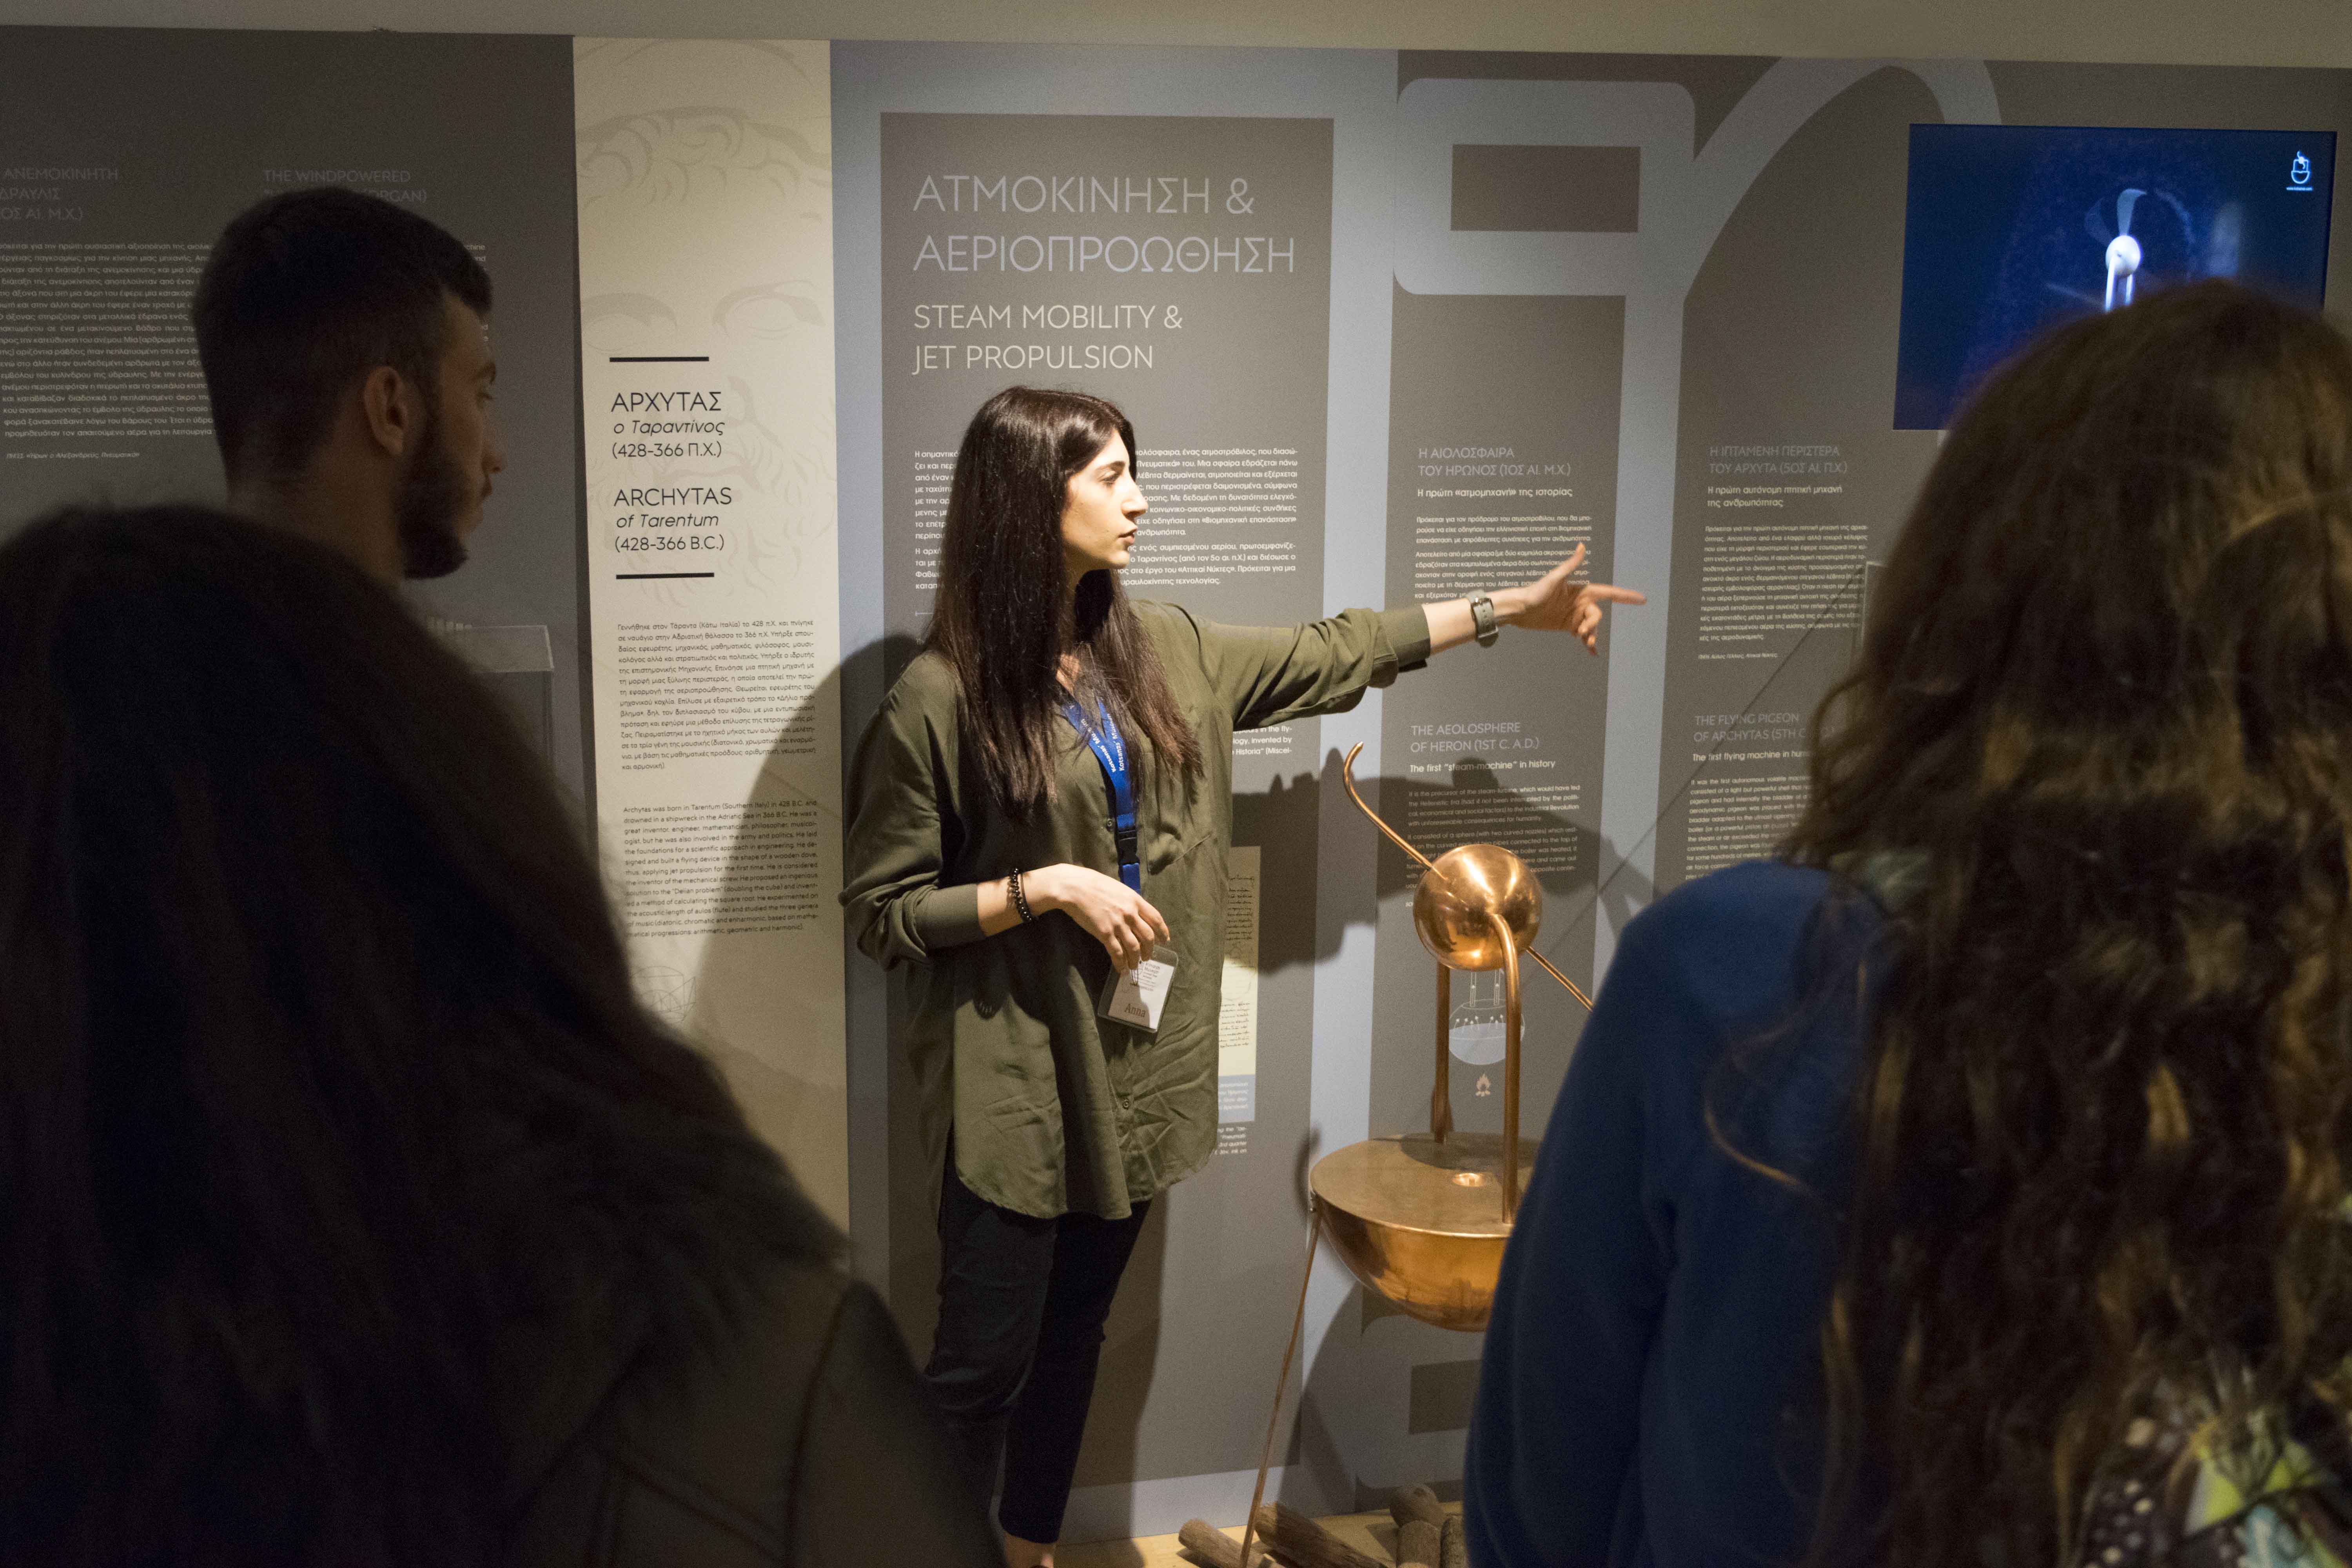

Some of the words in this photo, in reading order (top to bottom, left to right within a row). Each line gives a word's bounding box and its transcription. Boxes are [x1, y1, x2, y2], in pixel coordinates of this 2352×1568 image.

[914, 175, 1208, 214] ΑΤΜΟΚΙΝΗΣΗ
[1227, 178, 1254, 214] &
[1, 206, 20, 220] ΟΣ
[913, 235, 1294, 272] ΑΕΡΙΟΠΡΟΩΘΗΣΗ
[915, 305, 1009, 328] STEAM
[1024, 305, 1155, 328] MOBILITY
[1165, 305, 1181, 328] &
[911, 346, 956, 375] JET
[967, 345, 1152, 368] PROPULSION
[611, 392, 721, 412] ΑΡΧΥΤΑΣ
[613, 423, 624, 434] ο
[632, 420, 725, 436] Ταραντίνος
[612, 443, 684, 459] (428-366
[688, 441, 722, 457] Π.Χ.)
[1419, 448, 1427, 458] Η
[1431, 447, 1514, 458] ΑΙΟΛΟΣΦΑΙΡΑ
[1418, 466, 1443, 476] ΤΟΥ
[1446, 465, 1497, 475] ΗΡΩΝΟΣ
[1499, 464, 1524, 477] (1ΟΣ
[1527, 465, 1541, 475] ΑΙ.
[1544, 463, 1571, 476] Μ.Χ.)
[613, 487, 732, 506] ARCHYTAS
[1426, 489, 1453, 498] πρώτη
[1455, 488, 1516, 497] «ατμομηχανή»
[1535, 488, 1572, 497] ιστορίας
[616, 514, 635, 528] of
[641, 514, 719, 527] Tarentum
[1137, 528, 1186, 536] ανθρωπότητα.
[614, 536, 686, 553] (428-366
[690, 534, 724, 550] B.C.)
[1121, 578, 1174, 586] υραυλοκίνητης
[1080, 718, 1100, 744] Muem
[1107, 713, 1118, 740] Museum
[1411, 725, 1433, 735] THE
[1436, 722, 1520, 735] AEOLOSPHERE
[1410, 742, 1427, 752] OF
[1430, 740, 1471, 751] HERON
[1474, 739, 1496, 751] (1ST
[1499, 739, 1510, 749] C.
[1513, 737, 1539, 749] A.D.)
[1444, 761, 1517, 771] "steam-machine"
[1124, 1004, 1146, 1018] Anna
